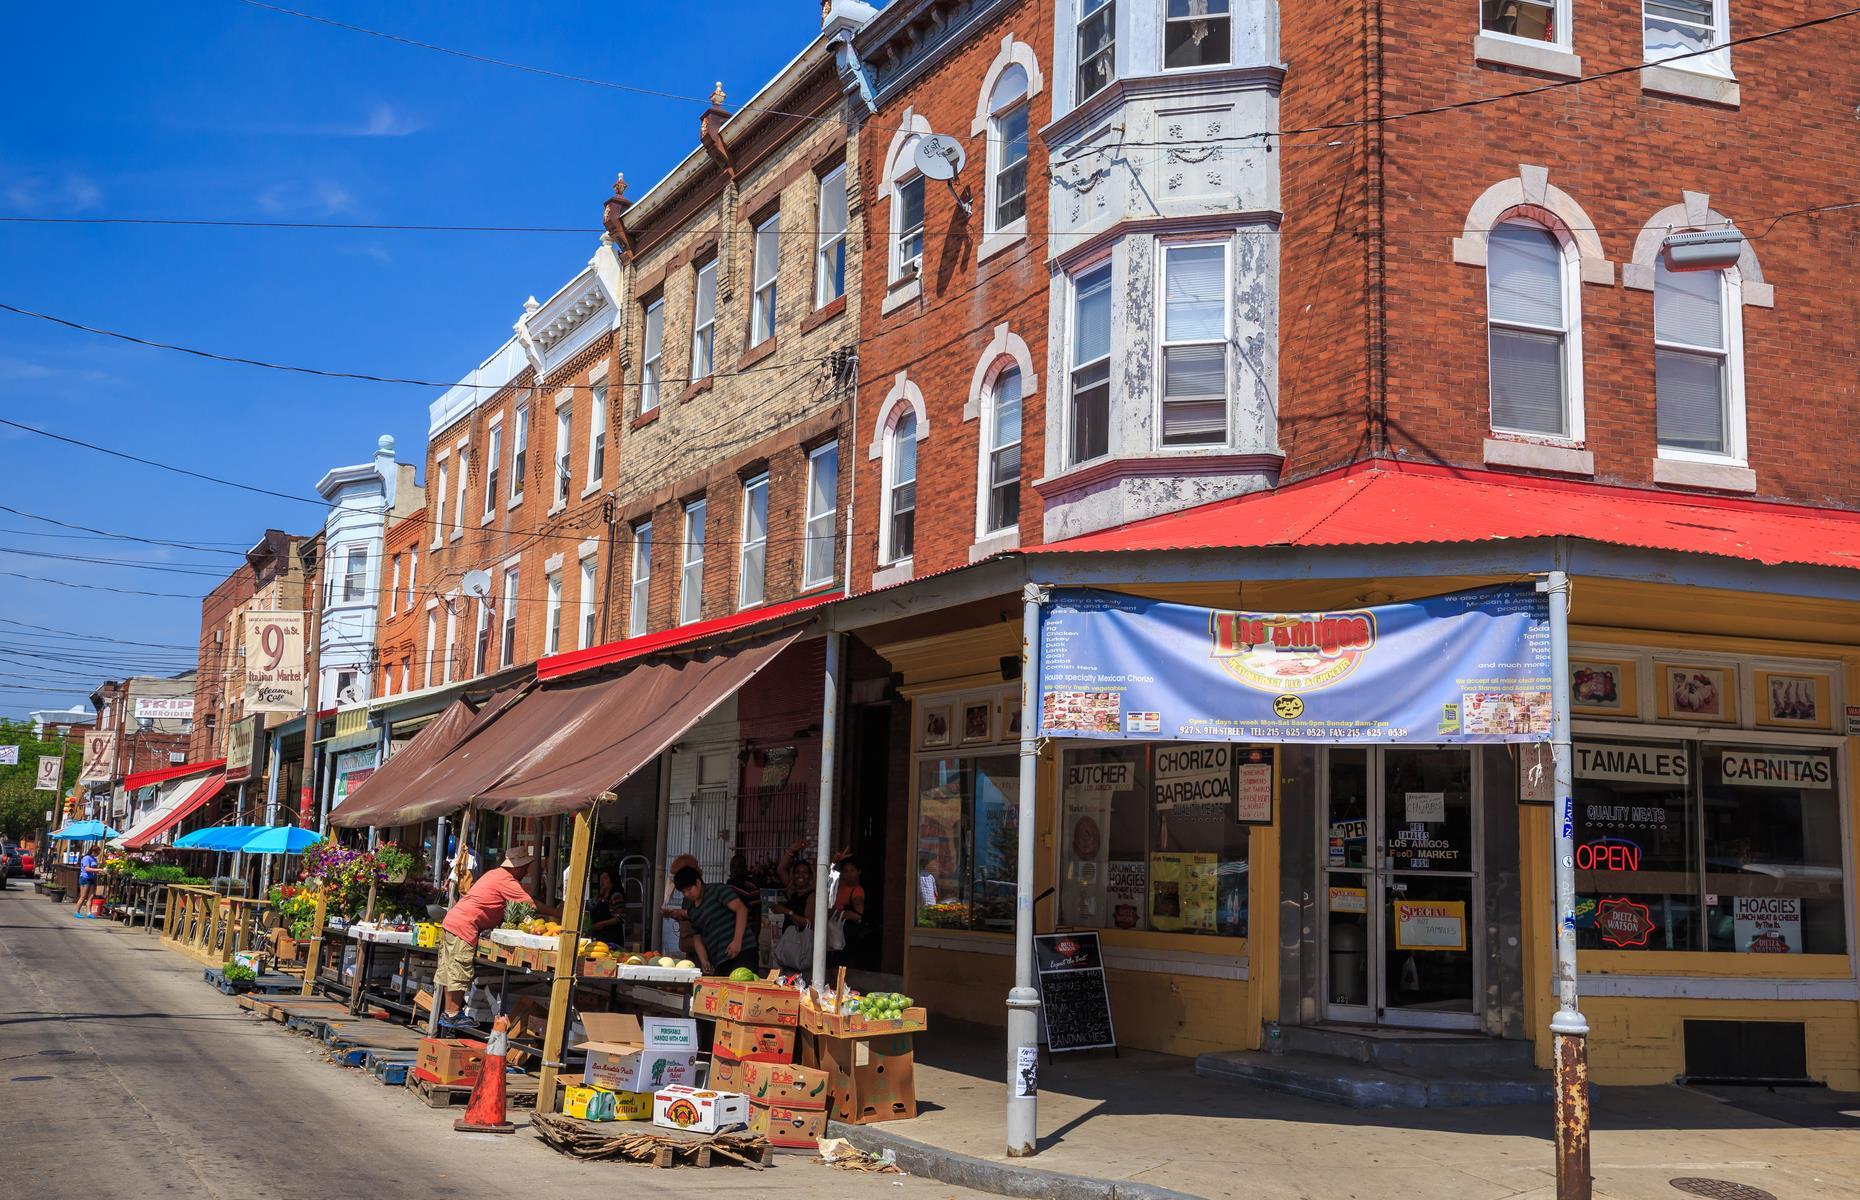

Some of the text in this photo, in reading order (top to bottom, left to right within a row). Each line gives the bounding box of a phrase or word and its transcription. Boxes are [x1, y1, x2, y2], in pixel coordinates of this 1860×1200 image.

[1497, 604, 1535, 612] products
[254, 626, 261, 635] S.
[290, 626, 300, 635] St.
[1271, 614, 1370, 655] Amigos
[248, 669, 302, 682] Italian Market
[1044, 673, 1064, 681] House
[1098, 674, 1125, 682] Mexican
[1127, 673, 1154, 683] Chorizo
[1188, 718, 1207, 726] Open
[1179, 726, 1408, 737] 927 S. 9TH STREET TEL: 215 625 0528 FAX: 215 625 0538
[1158, 747, 1227, 773] CHORIZO
[1577, 748, 1687, 777] TAMALES
[44, 761, 53, 777] 9
[1069, 765, 1127, 785] BUTCHER
[1722, 756, 1828, 783] CARNITAS
[1155, 777, 1231, 804] BARBACOA
[1587, 804, 1666, 823] QUALITY MEATS
[1410, 823, 1424, 832] HOT
[1398, 831, 1430, 840] TAMALES
[1389, 839, 1450, 848] LOS AMIGOS
[1417, 850, 1459, 859] MARKET
[1576, 844, 1638, 871] OPEN
[1108, 863, 1145, 873] SANDWICHE
[1411, 859, 1430, 868] PUSH
[1109, 873, 1145, 887] HOAGIES
[1739, 898, 1796, 914] HOAGIES
[1399, 904, 1446, 922] SPECIAL
[1612, 911, 1639, 924] DIETZ &
[1736, 913, 1756, 921] LUNCH
[1778, 914, 1799, 922] CHEESE
[1607, 919, 1639, 932] WATSON
[660, 1027, 681, 1035] PERISHABLE
[771, 1072, 793, 1084] Dole
[615, 1104, 638, 1114] Villita
[771, 1108, 793, 1119] Dole
